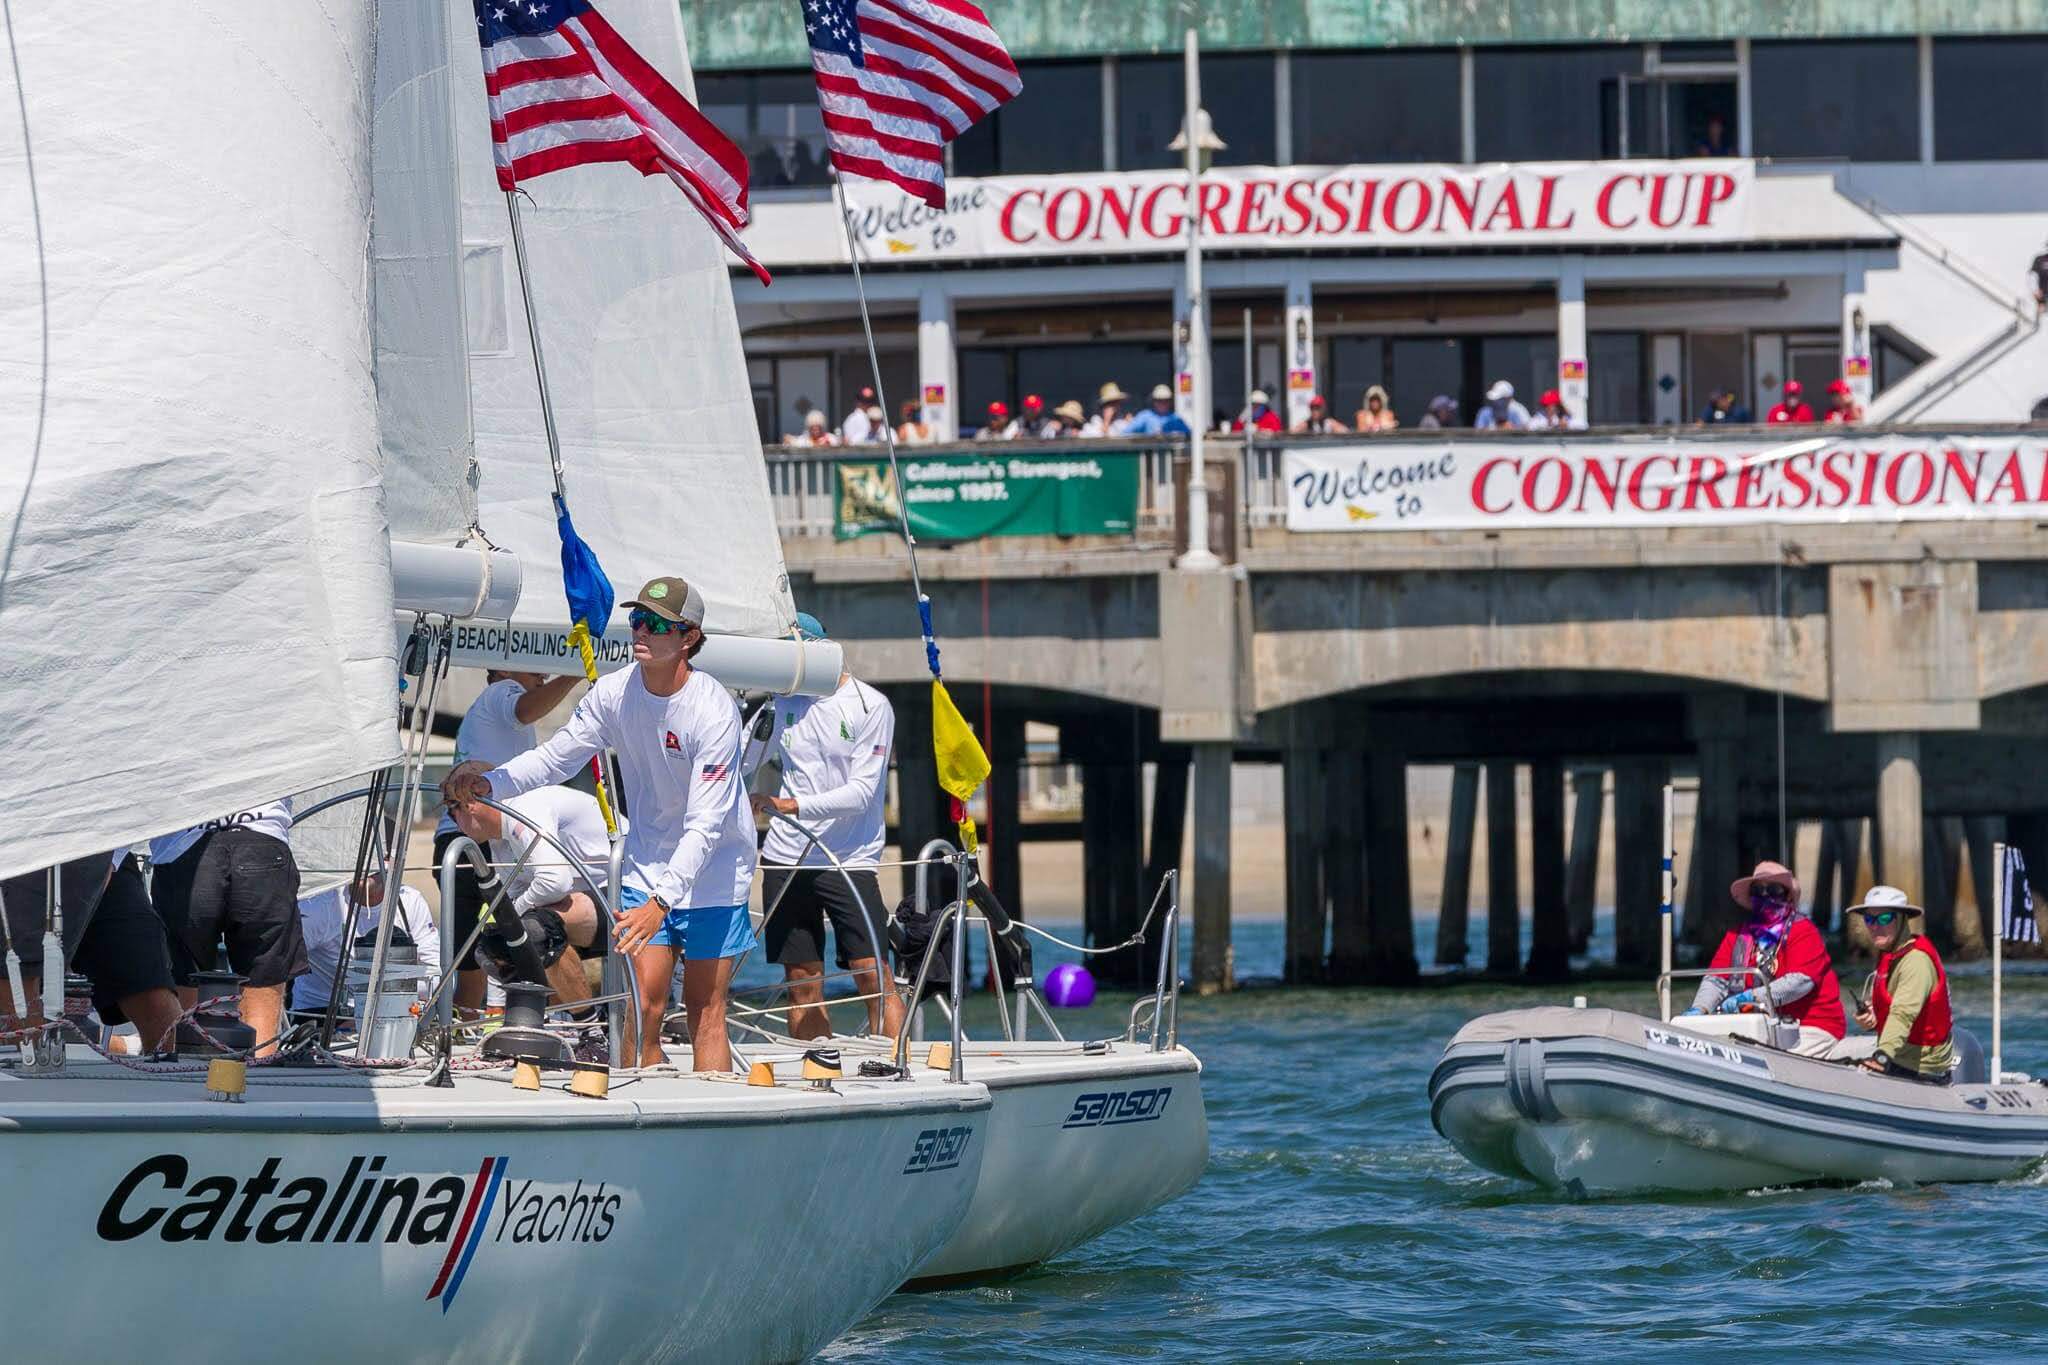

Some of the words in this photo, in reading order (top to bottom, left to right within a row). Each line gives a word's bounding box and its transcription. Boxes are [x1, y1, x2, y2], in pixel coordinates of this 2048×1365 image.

[999, 175, 1575, 244] CONGRESSIONAL
[1596, 173, 1736, 229] CUP
[931, 226, 956, 249] to
[1294, 452, 1457, 508] Welcome
[1471, 449, 2048, 514] CONGRESSIONA
[1395, 494, 1421, 518] to
[456, 626, 507, 652] BEACH
[511, 630, 567, 657] SAILING
[1650, 1028, 1668, 1044] CF
[96, 1154, 466, 1244] Catalina
[494, 1179, 622, 1243] Yachts
